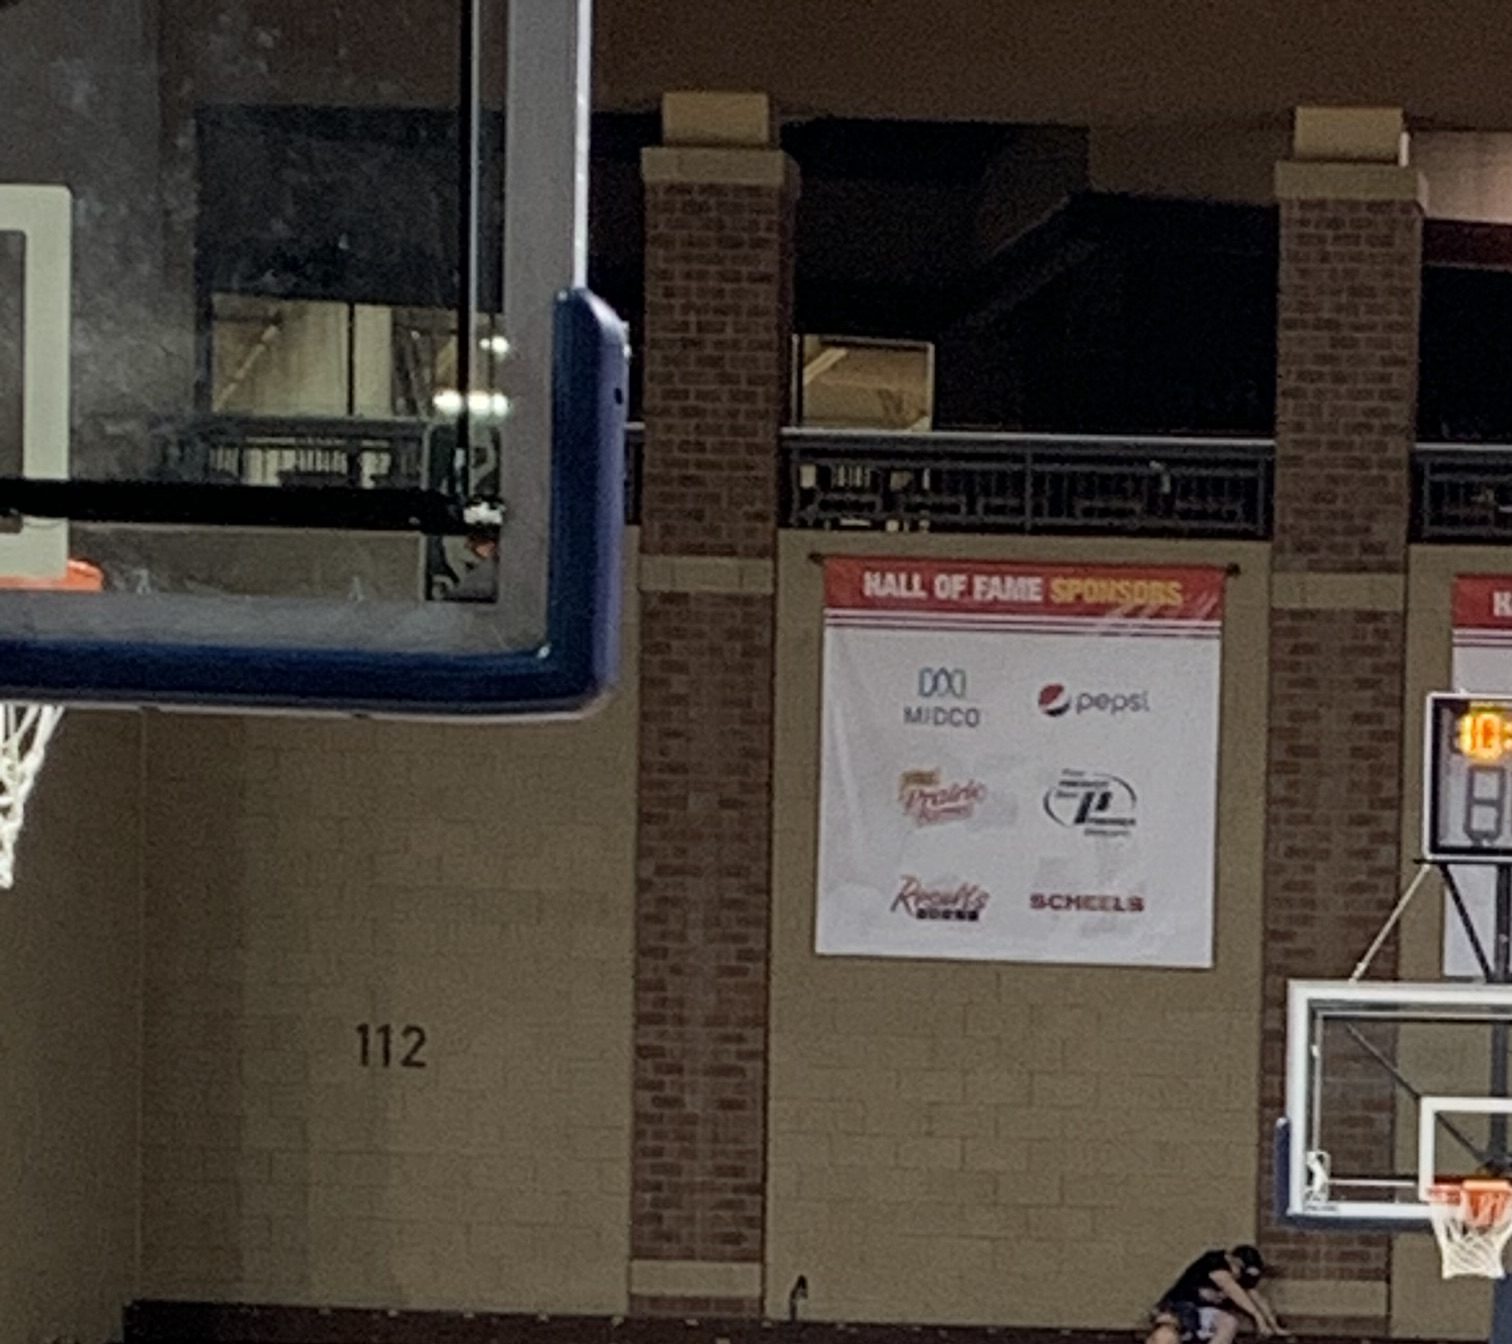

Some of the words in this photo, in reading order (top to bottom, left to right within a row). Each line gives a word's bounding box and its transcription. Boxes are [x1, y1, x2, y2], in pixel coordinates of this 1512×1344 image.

[864, 571, 926, 598] HALL
[934, 574, 965, 600] OF
[973, 576, 1042, 602] FAME
[1050, 578, 1183, 607] SPONSORS
[904, 706, 981, 728] MIDCO
[1076, 689, 1150, 717] pepsi
[1029, 893, 1145, 913] SCHEELS
[356, 1022, 427, 1069] 112
